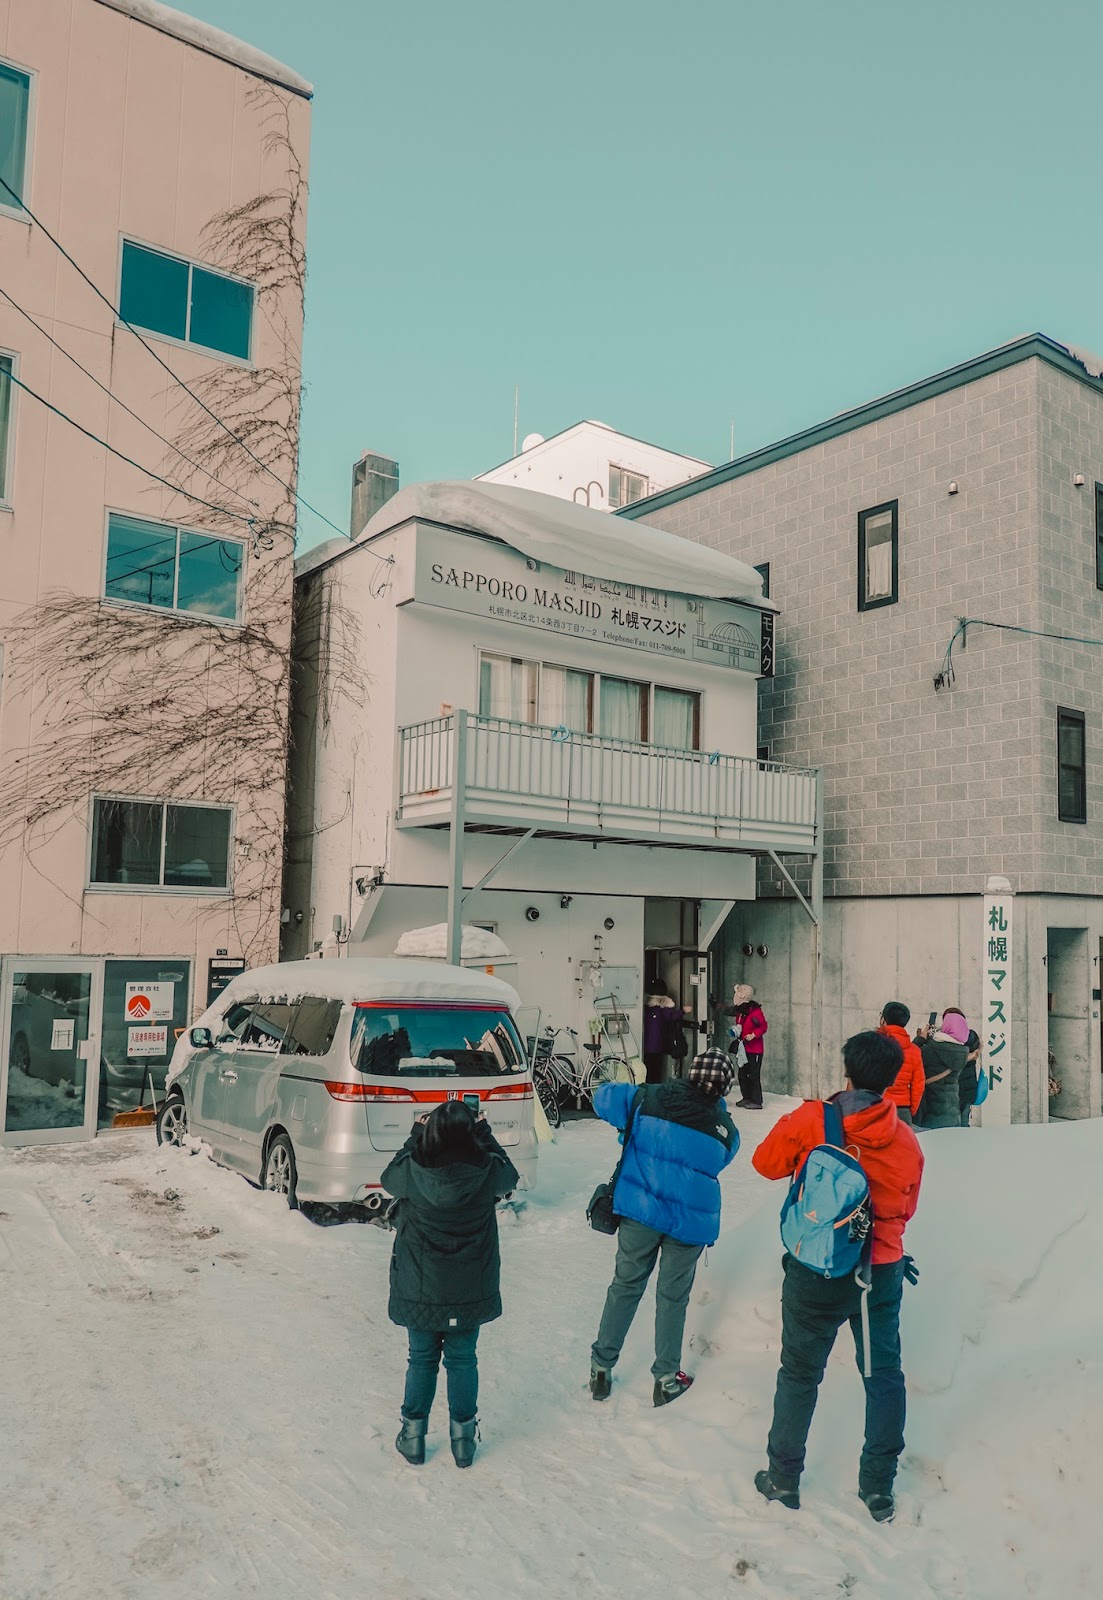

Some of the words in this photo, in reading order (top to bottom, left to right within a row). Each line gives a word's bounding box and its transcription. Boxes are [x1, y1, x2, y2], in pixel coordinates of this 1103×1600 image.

[431, 563, 527, 602] SAPPORO
[533, 587, 601, 619] MASJID
[602, 631, 648, 647] Telephone/Fax:
[611, 607, 686, 638] 札幌マスジド
[762, 616, 772, 671] モスク
[987, 905, 1008, 1091] 札幌マスジド
